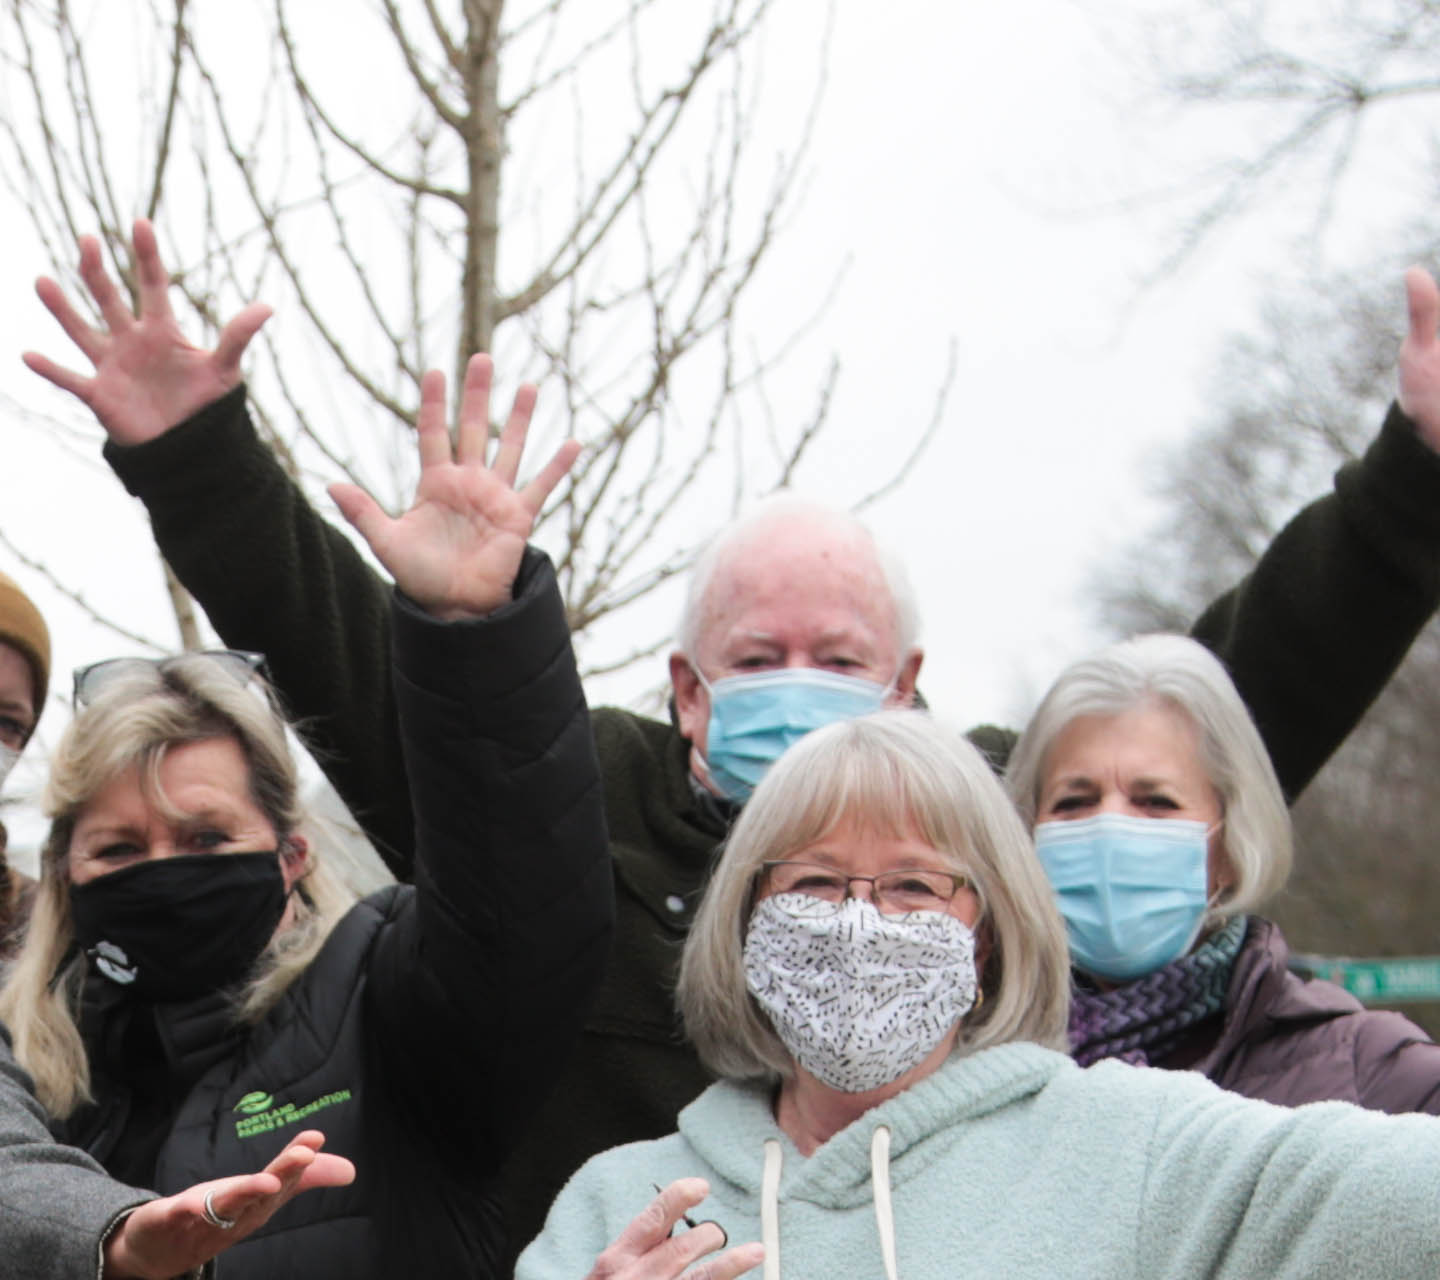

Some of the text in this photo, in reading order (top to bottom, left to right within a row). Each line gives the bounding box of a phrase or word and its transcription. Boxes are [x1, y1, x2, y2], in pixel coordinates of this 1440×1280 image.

[235, 1103, 296, 1129] PORTLAND
[237, 1121, 275, 1138] PARKS
[285, 1089, 351, 1122] RECREATION
